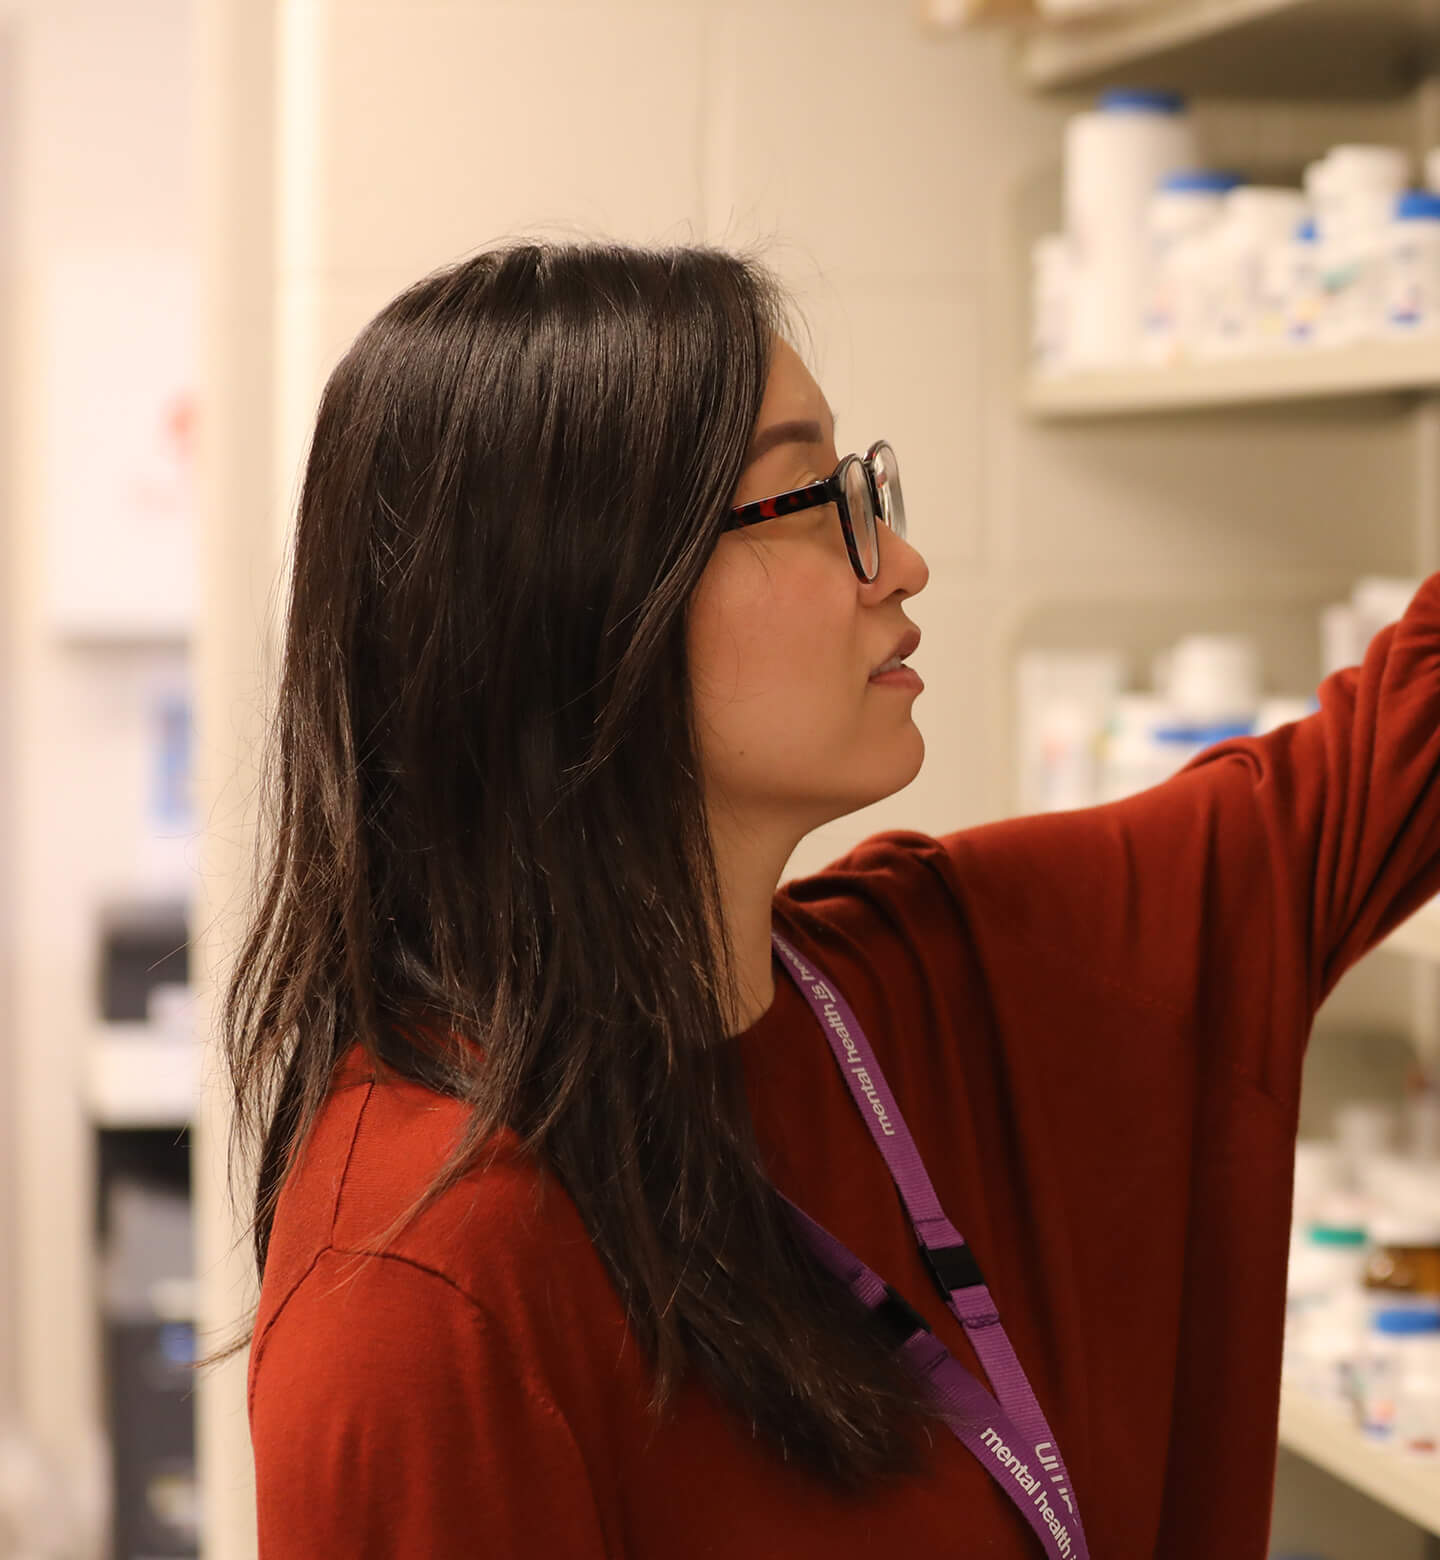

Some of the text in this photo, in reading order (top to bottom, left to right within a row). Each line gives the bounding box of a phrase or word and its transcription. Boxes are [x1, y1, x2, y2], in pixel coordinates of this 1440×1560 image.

[811, 981, 837, 1003] is
[824, 1003, 862, 1064] health
[852, 1067, 895, 1137] mental
[980, 1427, 1042, 1497] mental
[1033, 1490, 1072, 1560] health
